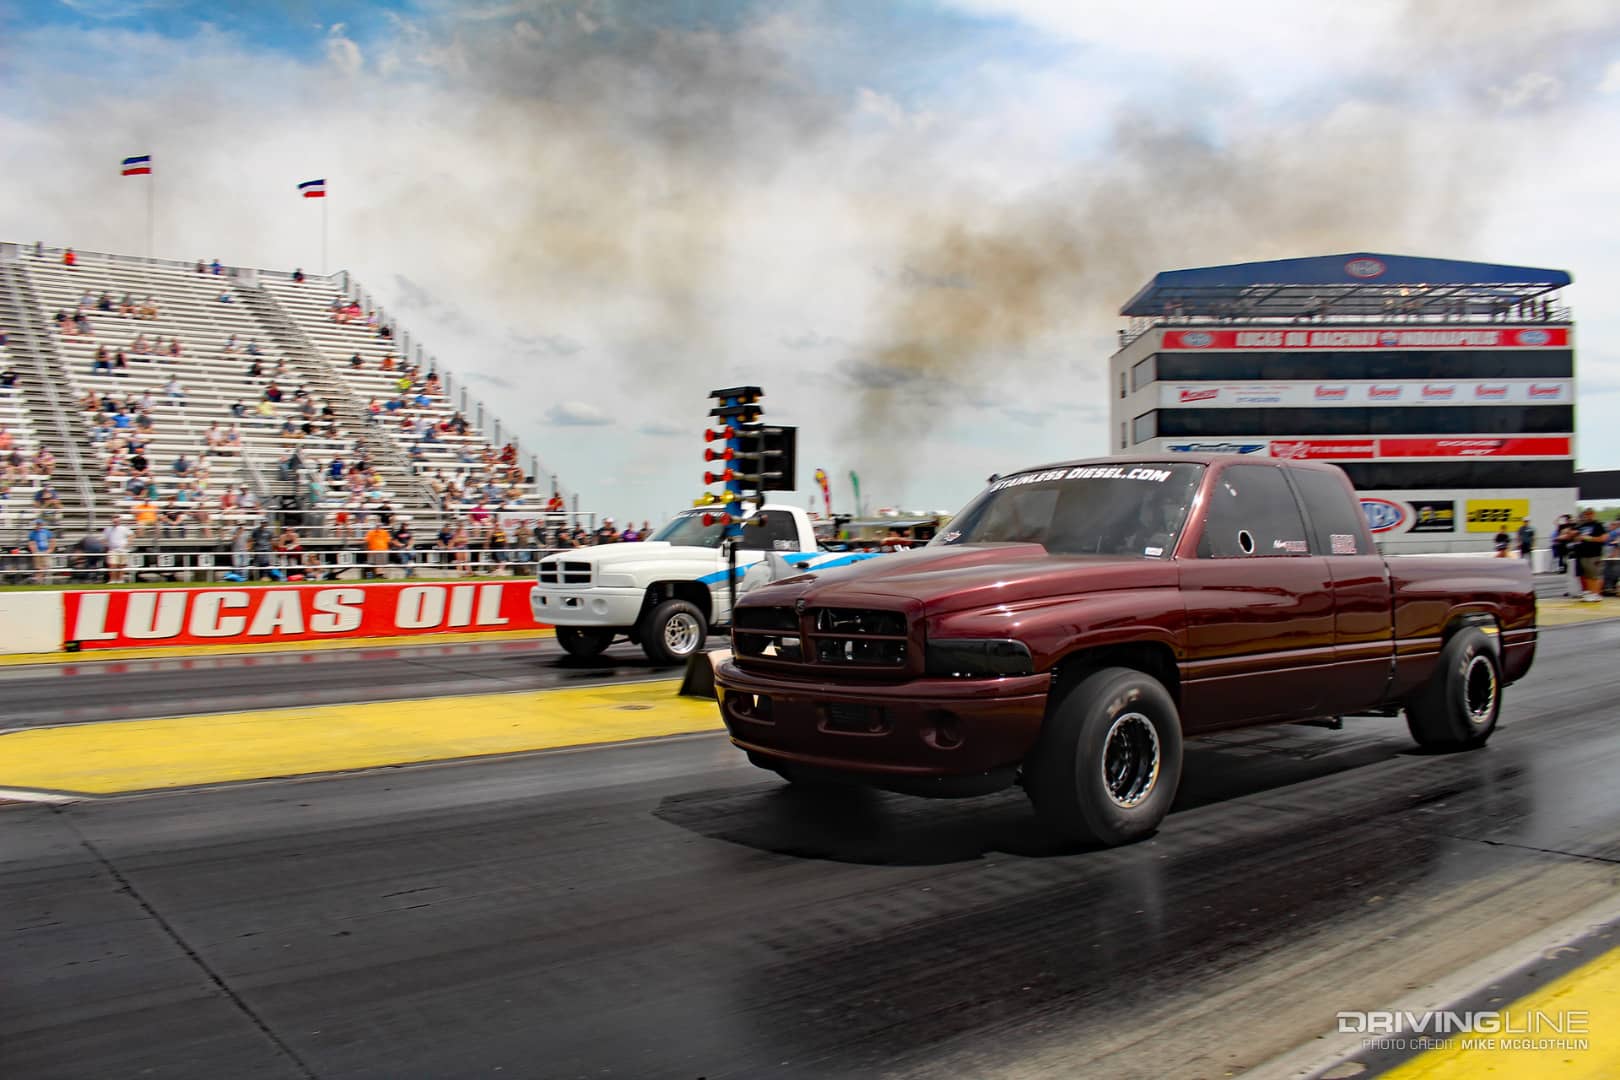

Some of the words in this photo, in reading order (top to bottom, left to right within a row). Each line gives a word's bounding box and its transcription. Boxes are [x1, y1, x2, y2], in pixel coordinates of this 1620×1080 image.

[1065, 467, 1172, 482] DIESEL.COM
[74, 588, 365, 641] LUCAS
[395, 585, 509, 628] OIL
